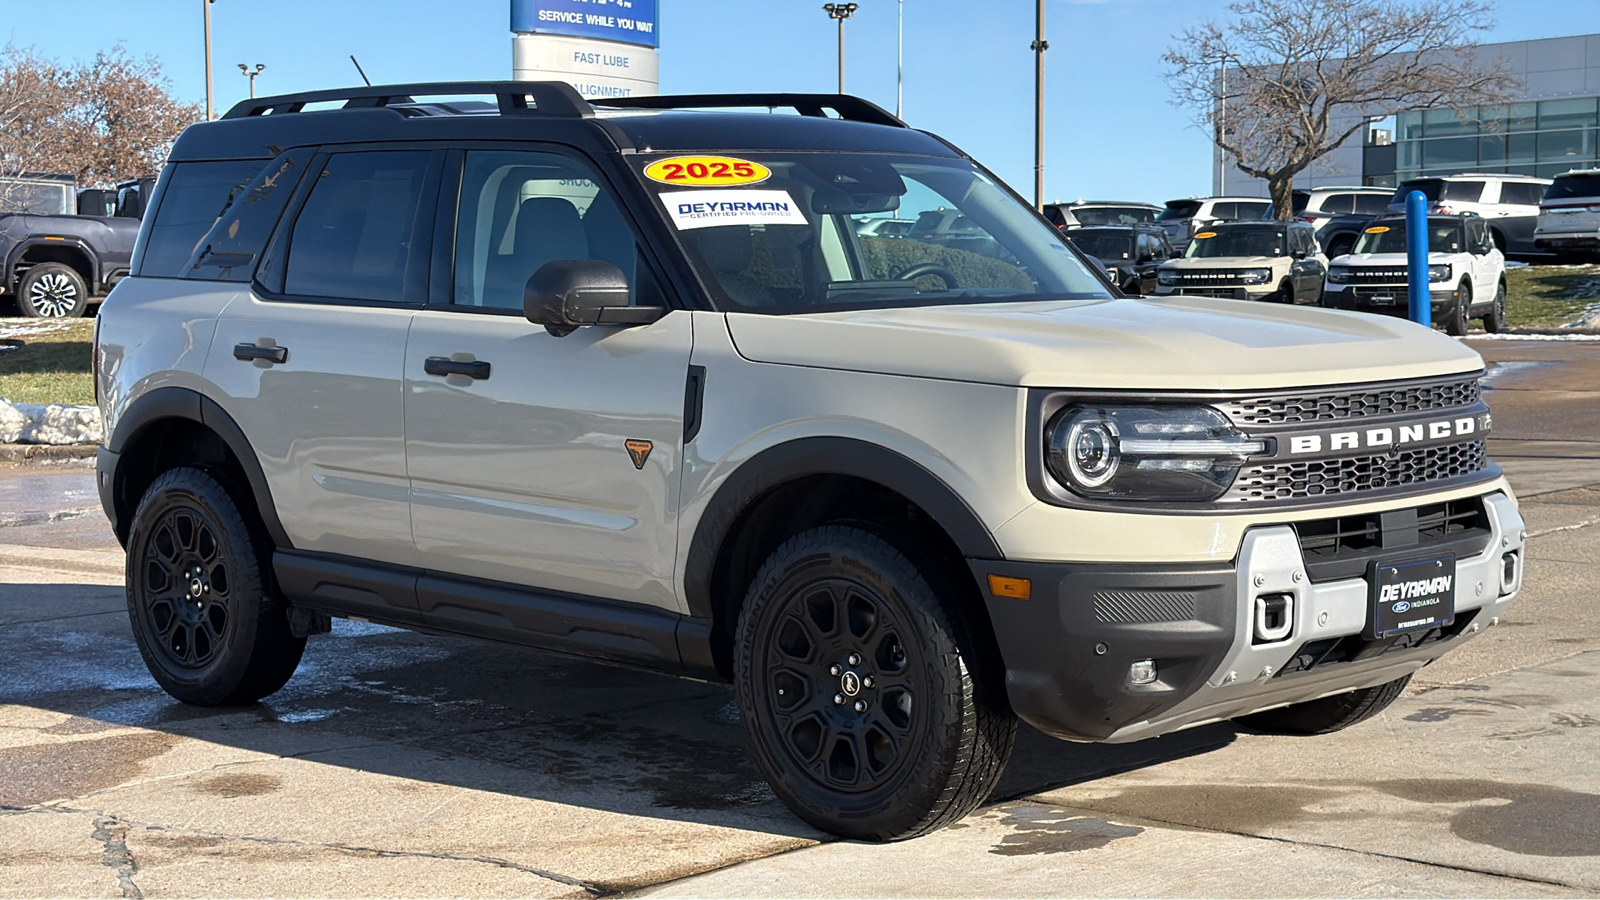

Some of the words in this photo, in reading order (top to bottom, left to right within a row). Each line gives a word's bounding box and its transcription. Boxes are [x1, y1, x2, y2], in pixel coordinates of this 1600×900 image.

[538, 10, 583, 24] SERVICE
[586, 14, 615, 28] WHILE
[617, 18, 634, 30] YOU
[636, 21, 653, 33] WAIT
[574, 52, 601, 64] FAST
[603, 55, 629, 68] LUBE
[662, 162, 756, 180] 2025
[678, 202, 789, 214] DEYARMAN
[690, 211, 737, 219] CERTIFIED
[1290, 417, 1475, 454] BRONCO
[1379, 575, 1452, 602] DEYARMAN
[1411, 597, 1440, 608] INDIANOLA
